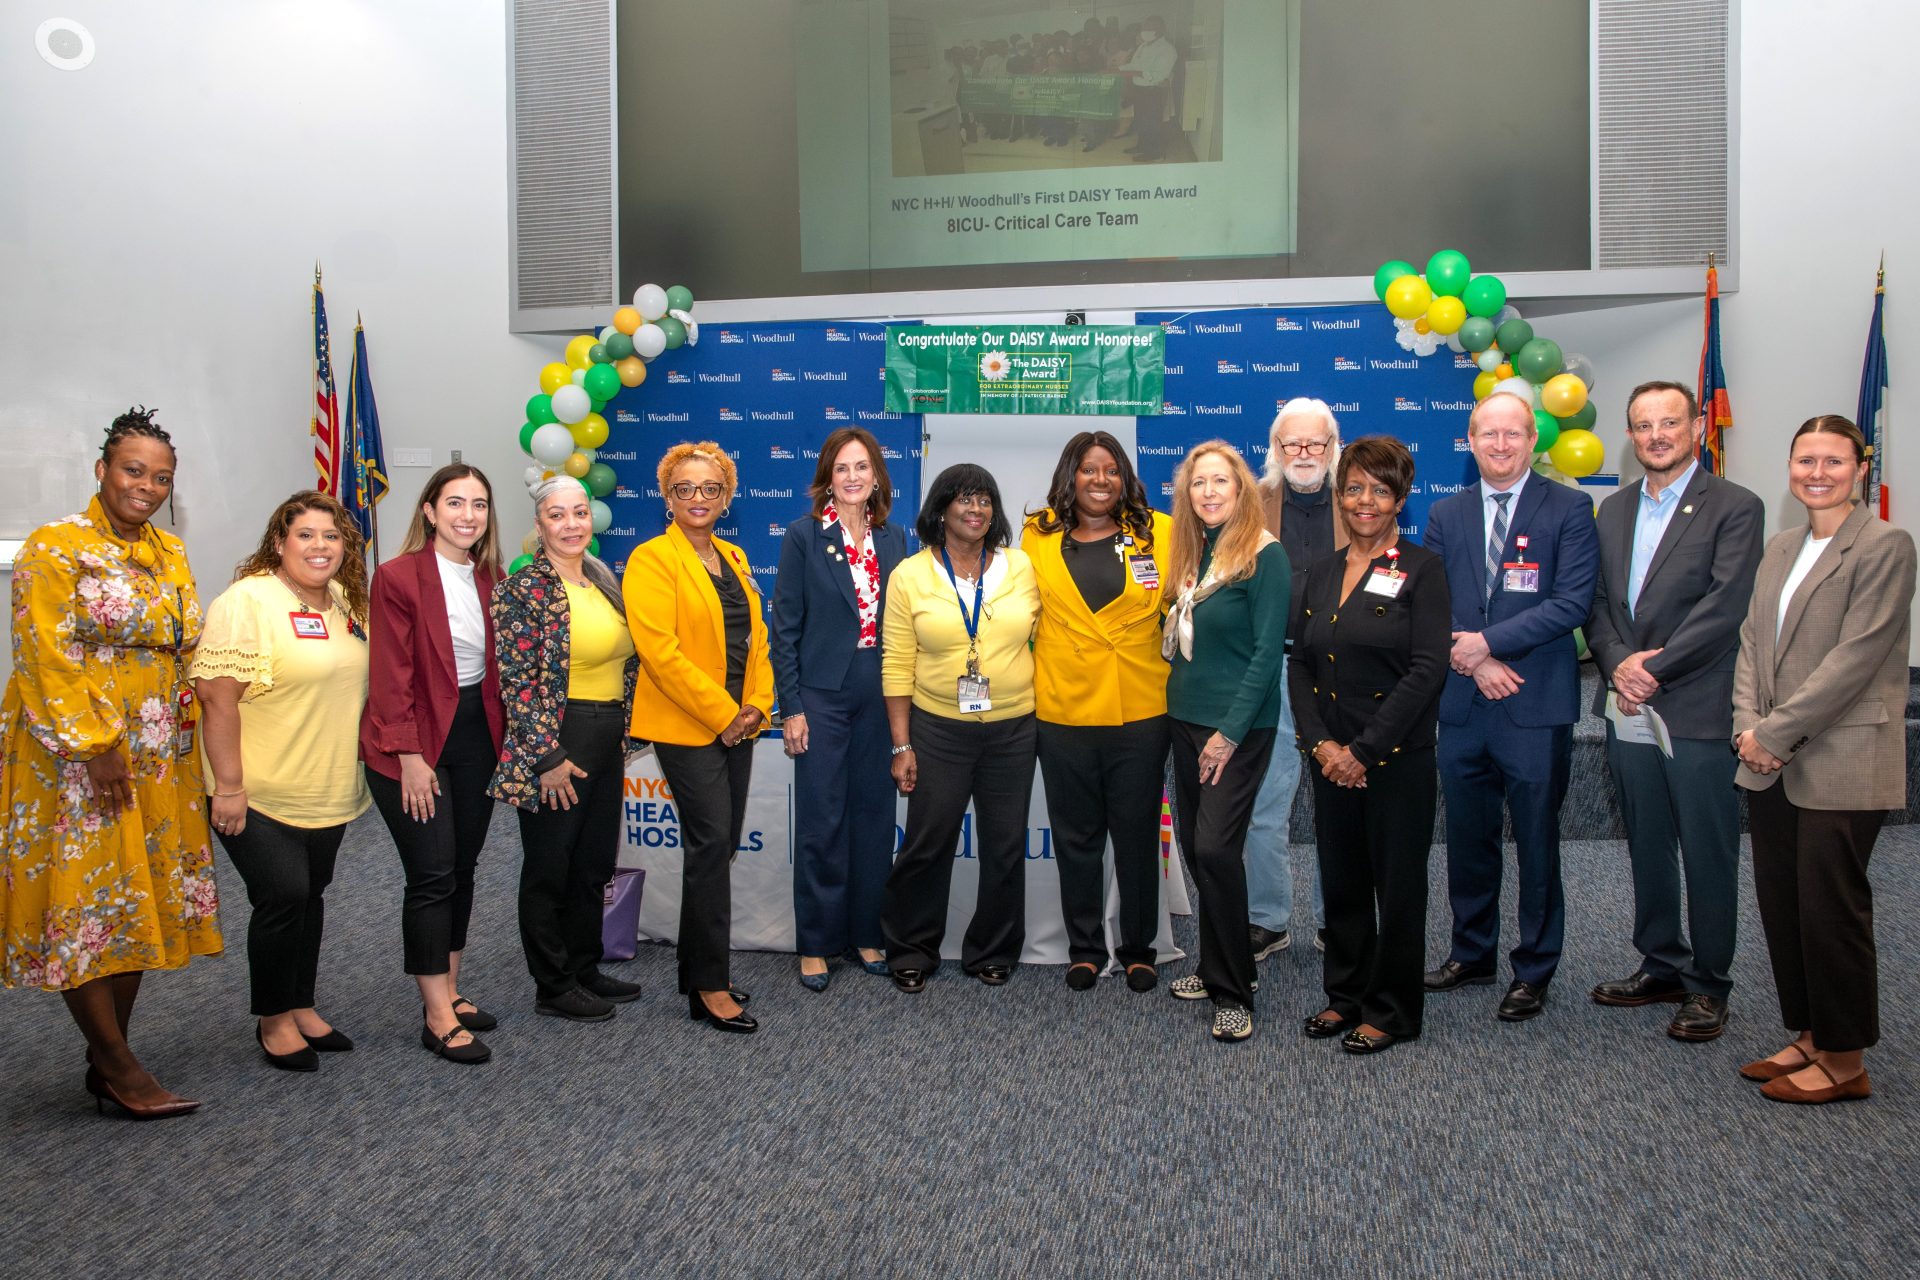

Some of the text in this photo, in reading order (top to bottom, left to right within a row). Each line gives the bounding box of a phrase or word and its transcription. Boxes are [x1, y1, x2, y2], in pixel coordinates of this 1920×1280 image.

[891, 185, 1197, 212] NYC H+H/ Woodhull's First DAISY Team Award
[947, 211, 1139, 233] 8ICU- Critical Care Team
[1195, 324, 1242, 333] Woodhull
[1312, 320, 1360, 330] Woodhull
[752, 334, 795, 342] Woodhull
[859, 332, 886, 341] Wood
[898, 332, 1153, 350] Congratulate Our DAISY Award Honoree!
[1012, 358, 1067, 368] The DAISY
[1252, 363, 1299, 372] Woodhull
[1370, 360, 1418, 369] Woodhull
[1022, 369, 1056, 378] Award
[1164, 366, 1184, 374] hull
[698, 374, 741, 382] Woodhull
[804, 372, 847, 381] Woodhull
[1195, 405, 1242, 414] Woodhull
[1431, 401, 1476, 410] Woodhul
[648, 413, 689, 422] Woodhull
[751, 412, 794, 420] Woodhull
[1138, 446, 1183, 455] Woodhull
[750, 489, 792, 498] Woodhull
[712, 528, 738, 536] odhull
